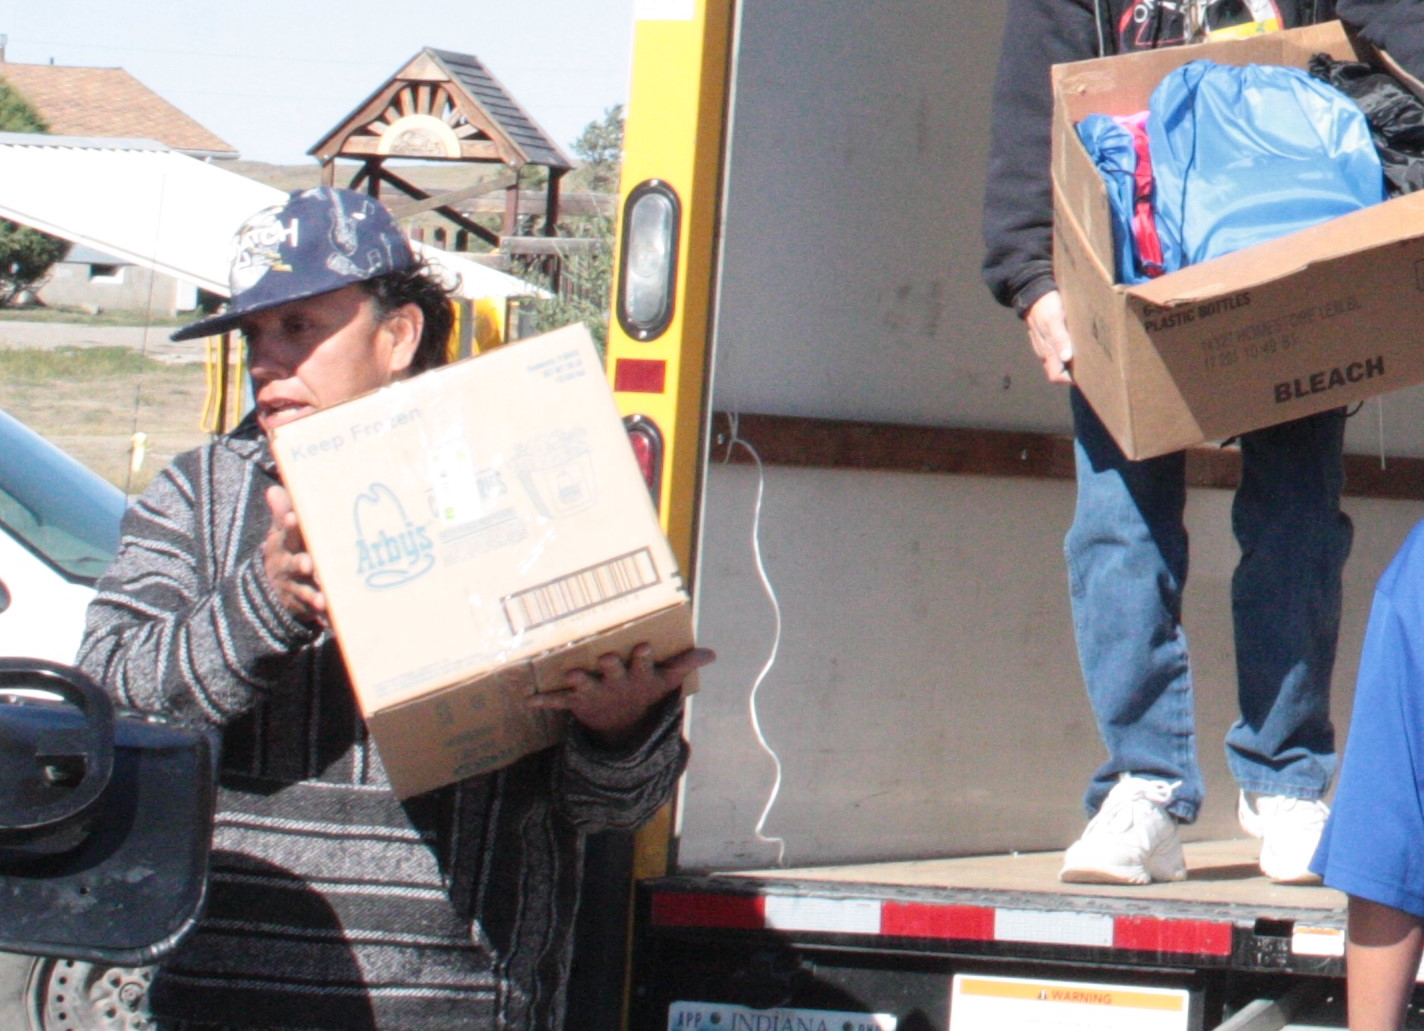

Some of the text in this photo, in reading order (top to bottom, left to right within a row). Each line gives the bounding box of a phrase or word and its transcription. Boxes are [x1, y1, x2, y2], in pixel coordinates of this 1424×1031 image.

[1144, 306, 1197, 333] PLASTIC
[1200, 291, 1252, 319] BOTTLES
[1273, 355, 1386, 405] BLEACH
[290, 435, 345, 464] Keep
[355, 521, 434, 574] Arby's
[1051, 988, 1113, 1006] WARNING
[730, 1012, 828, 1031] INDIANA
